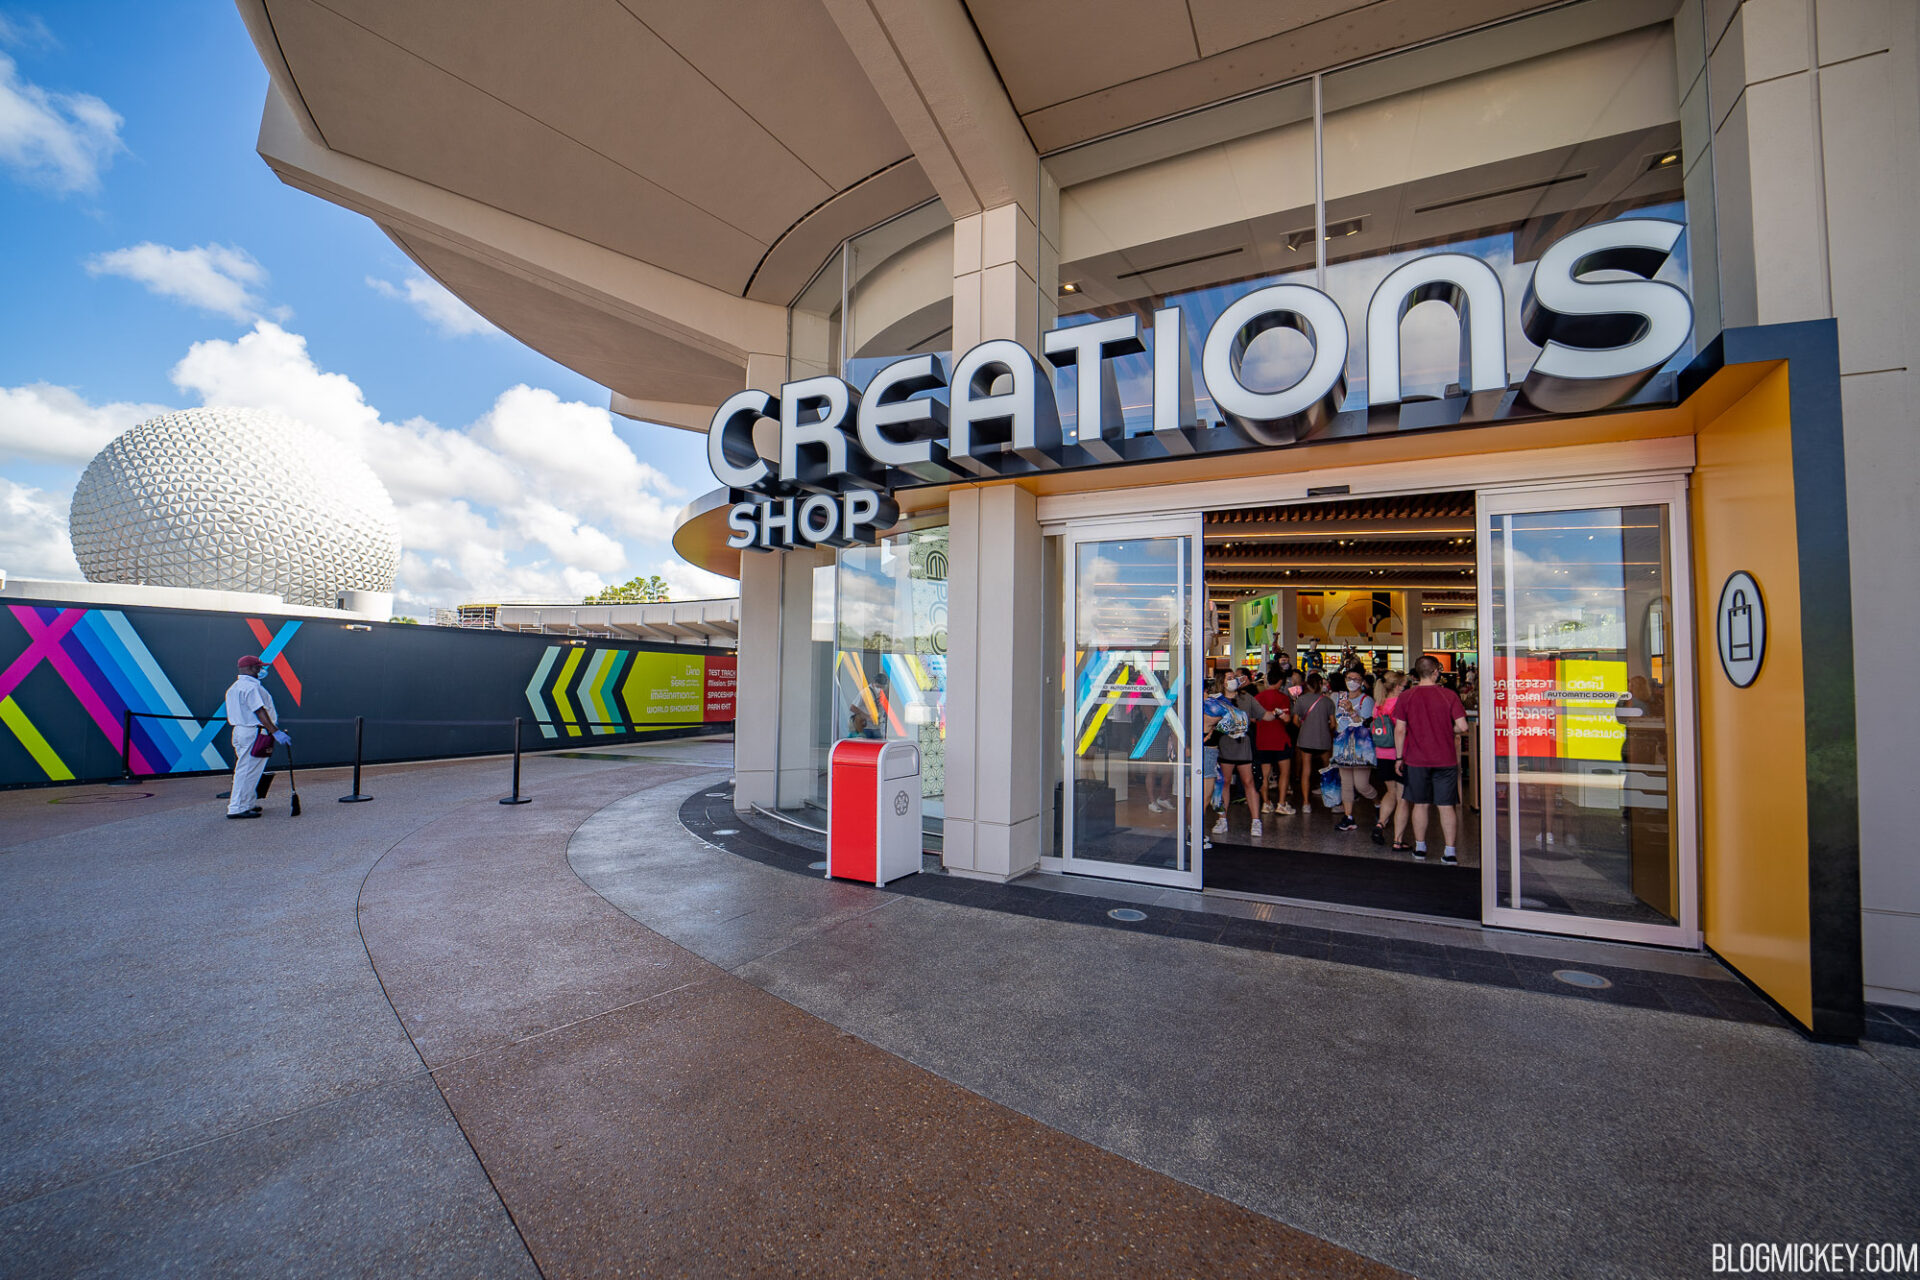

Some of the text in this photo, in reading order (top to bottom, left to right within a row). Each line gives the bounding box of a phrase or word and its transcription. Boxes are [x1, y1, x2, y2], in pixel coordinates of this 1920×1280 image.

[707, 217, 1695, 489] CREATIONS
[725, 489, 889, 552] SHOP
[647, 704, 699, 714] WORLD SHOWCASE
[707, 691, 734, 699] SPACESHIP
